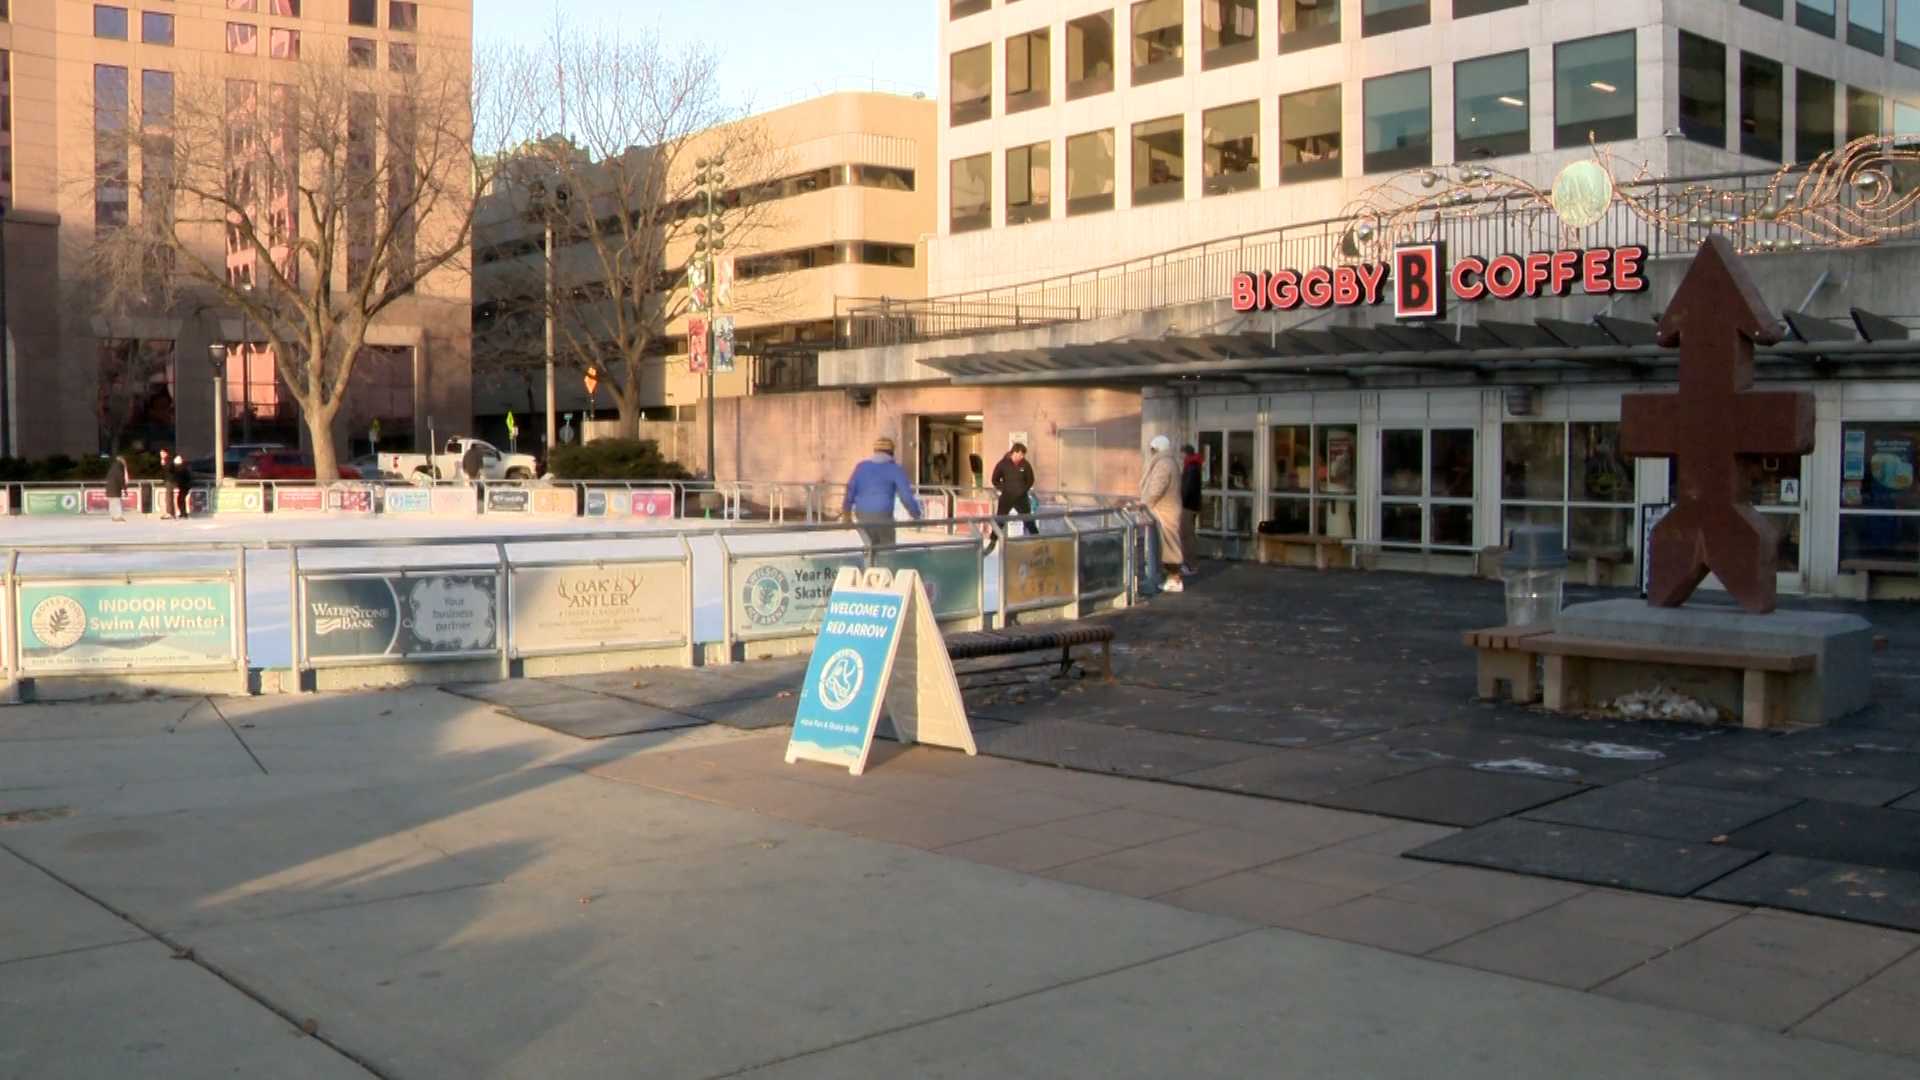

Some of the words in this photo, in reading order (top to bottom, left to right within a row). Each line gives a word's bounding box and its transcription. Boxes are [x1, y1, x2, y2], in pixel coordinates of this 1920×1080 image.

[1231, 263, 1386, 311] BIGGBY
[1450, 246, 1644, 299] COFFEE
[1784, 482, 1794, 494] A
[795, 568, 821, 582] Year
[824, 567, 839, 580] Ro
[575, 579, 609, 593] OAK
[795, 587, 833, 600] Skatin
[98, 597, 168, 612] INDOOR
[170, 596, 217, 611] POOL
[568, 594, 630, 607] ANTLER
[829, 602, 880, 617] WELCOME
[881, 605, 897, 619] TO
[90, 616, 134, 630] Swim
[137, 615, 160, 630] All
[163, 614, 225, 629] Winter!
[825, 621, 846, 635] RED
[846, 623, 888, 638] ARROW
